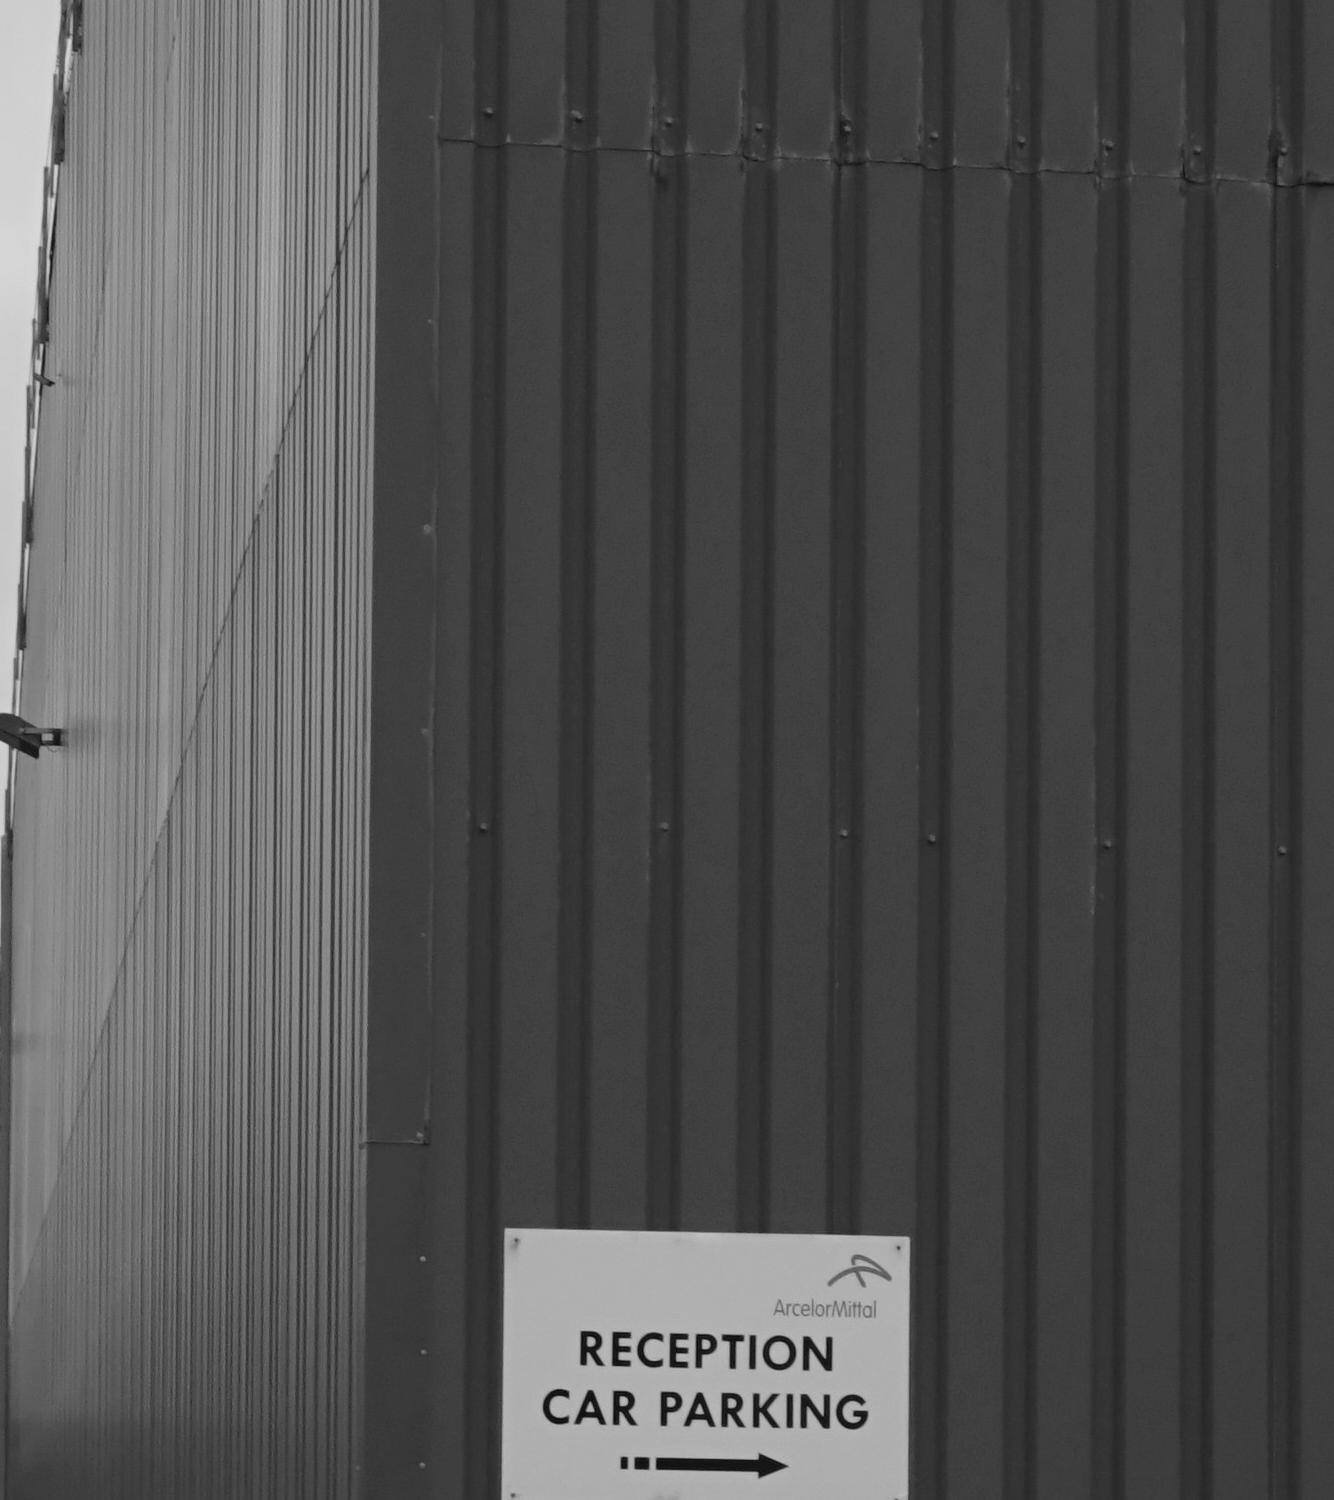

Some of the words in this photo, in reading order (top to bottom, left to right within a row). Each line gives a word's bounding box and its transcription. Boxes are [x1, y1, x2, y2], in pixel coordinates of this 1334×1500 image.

[773, 1298, 877, 1319] ArcelorMittal
[579, 1330, 833, 1372] RECEPTION
[542, 1388, 638, 1427] CAR
[659, 1390, 869, 1430] PARKING
